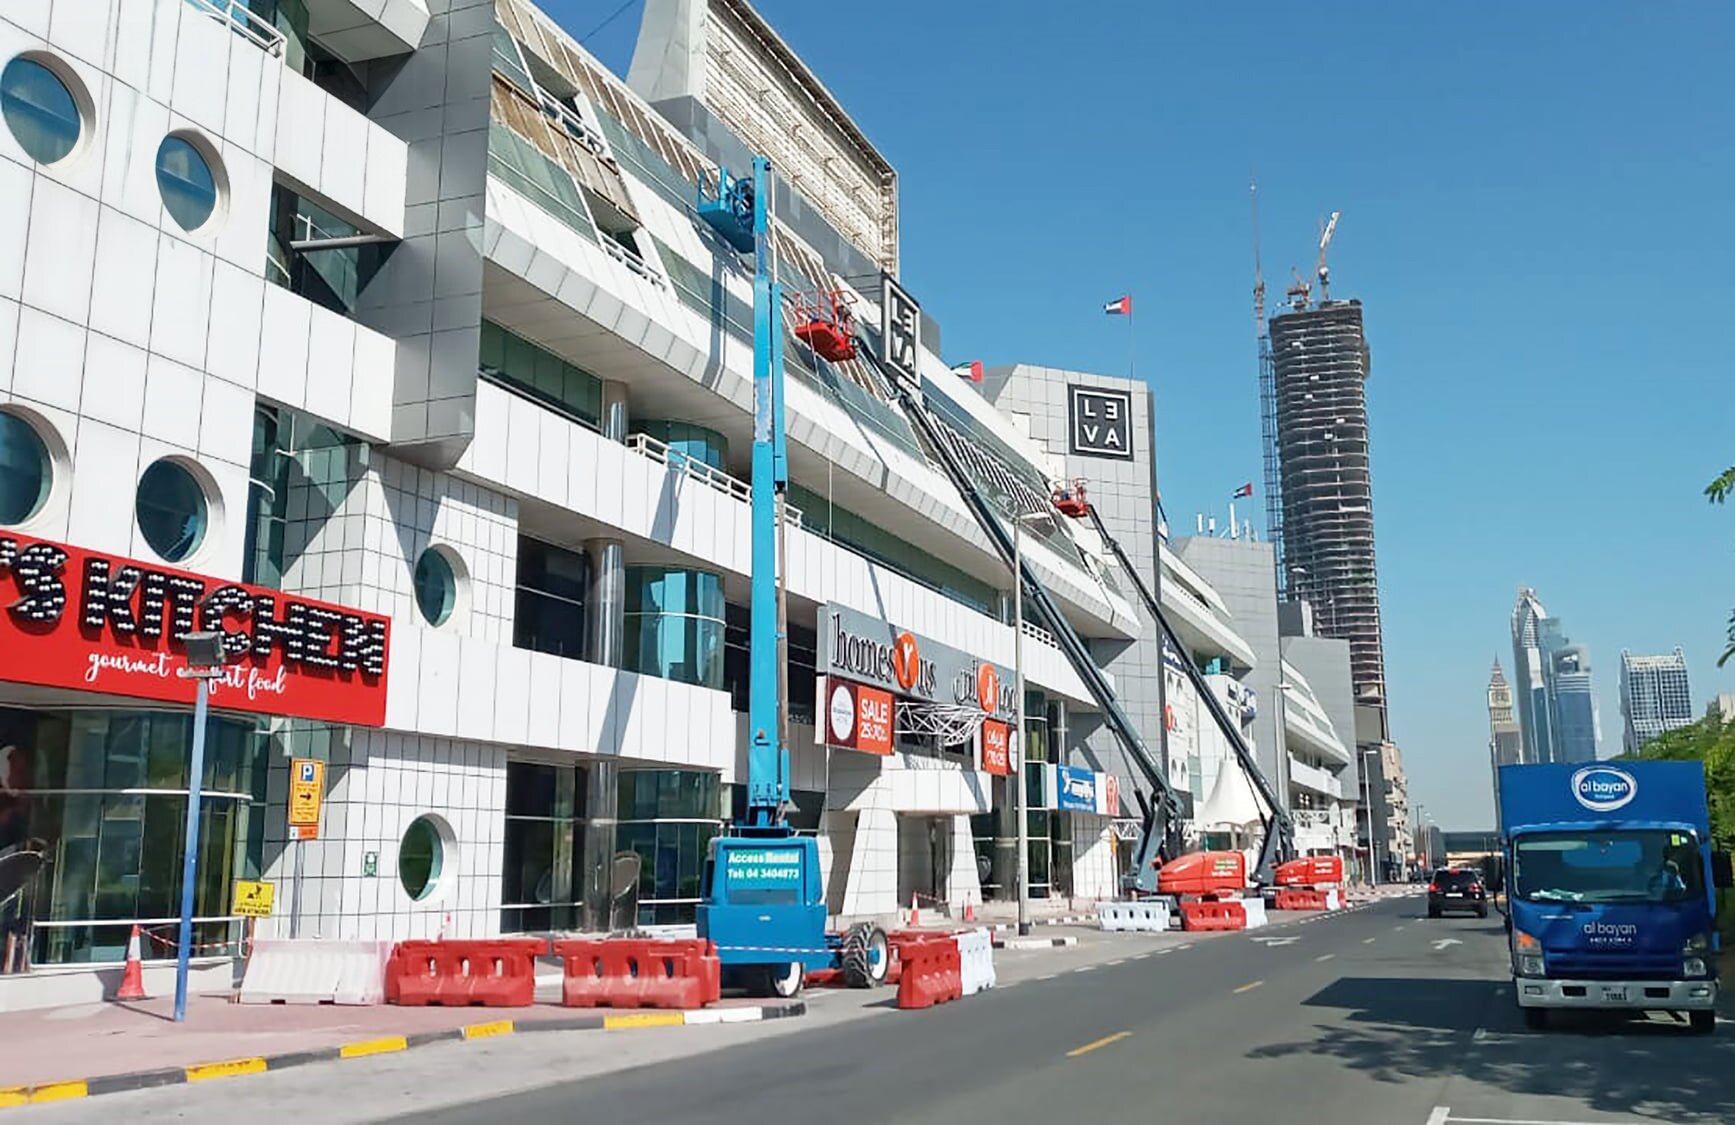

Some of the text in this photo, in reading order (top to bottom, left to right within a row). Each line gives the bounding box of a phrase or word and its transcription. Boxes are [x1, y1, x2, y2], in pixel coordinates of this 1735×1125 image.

[82, 557, 385, 677] KITCHEN
[831, 612, 896, 685] homes
[85, 652, 173, 683] gourmet
[247, 665, 286, 700] food
[861, 698, 888, 724] SALE
[302, 764, 313, 781] P
[1580, 780, 1629, 794] al bayan
[728, 851, 764, 863] Access
[1584, 921, 1637, 938] al bayan
